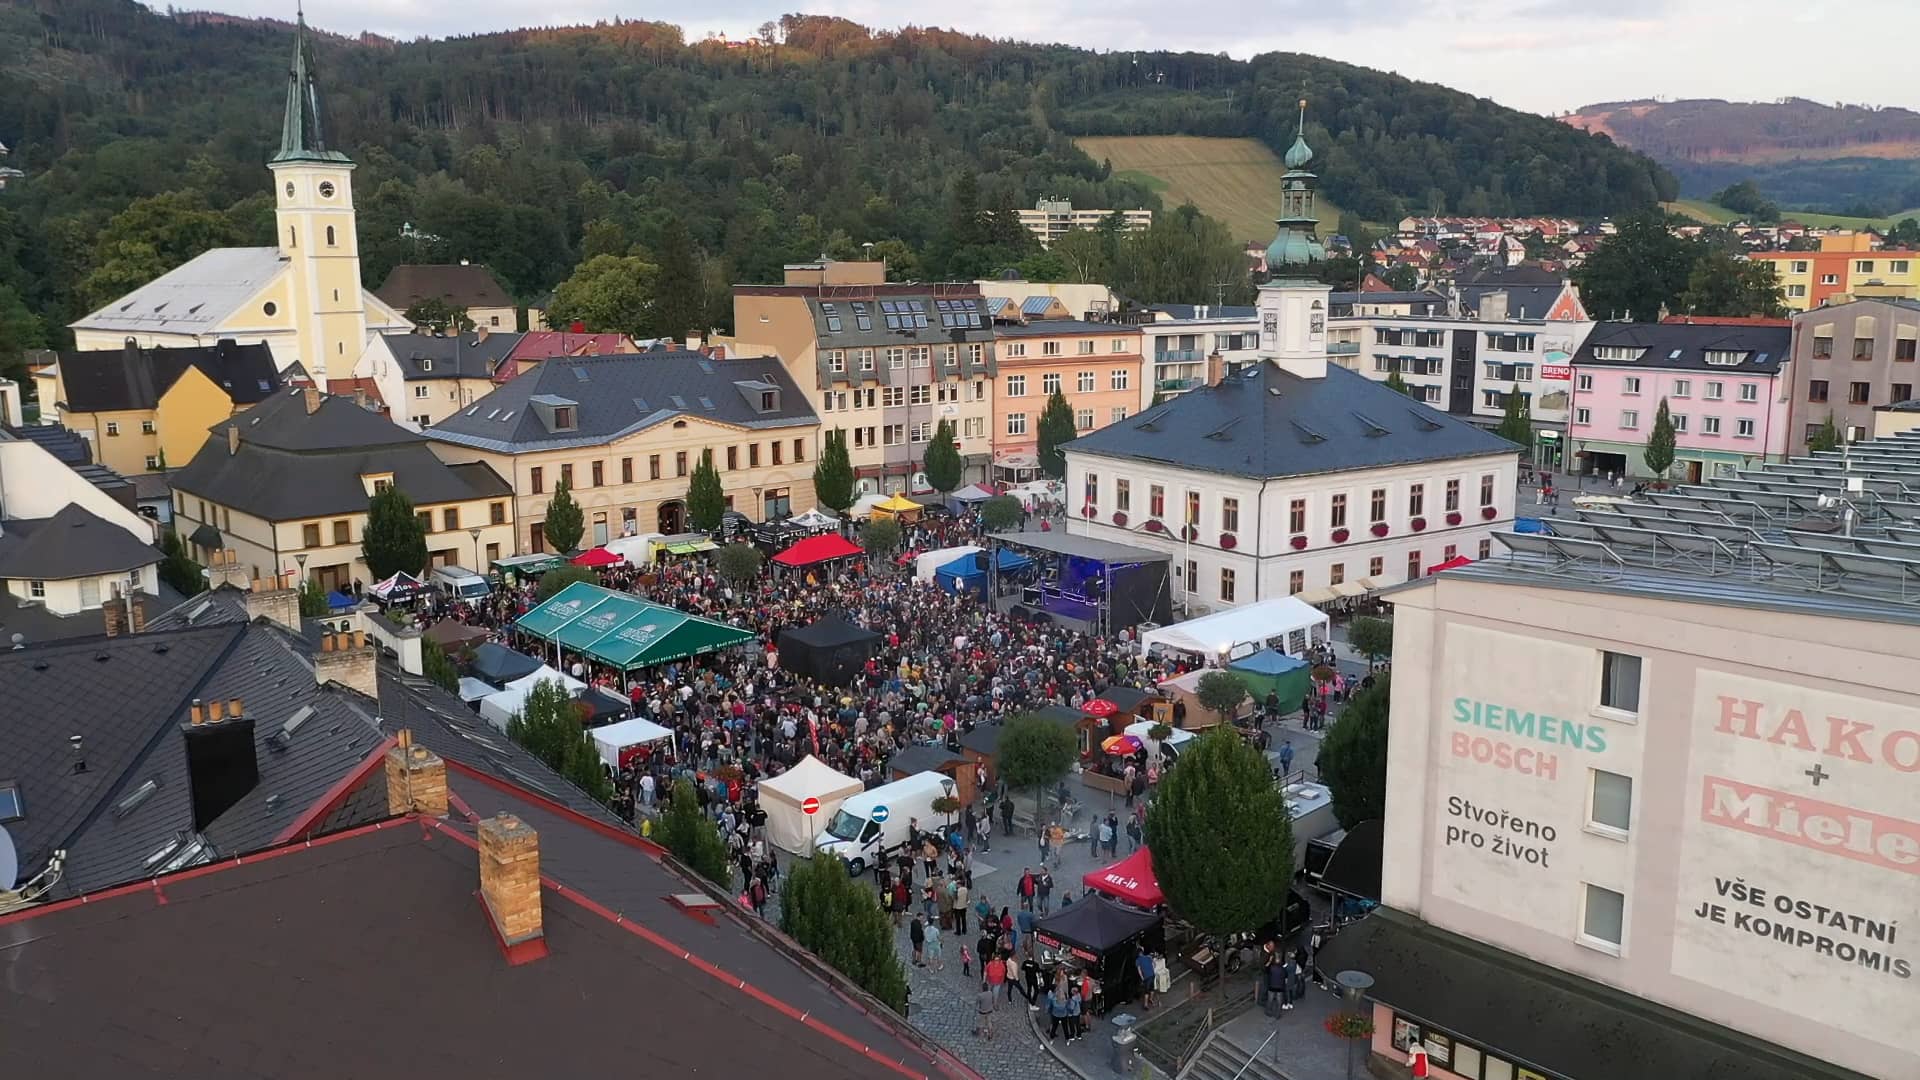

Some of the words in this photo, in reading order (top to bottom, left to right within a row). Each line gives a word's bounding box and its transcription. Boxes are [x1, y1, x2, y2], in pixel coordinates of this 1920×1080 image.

[1542, 366, 1570, 375] BRENO
[1453, 697, 1607, 753] SIEMENS
[1714, 695, 1920, 773] HAKO
[1451, 731, 1558, 781] BOSCH
[1446, 825, 1485, 848] pro
[1491, 834, 1549, 869] život
[1447, 796, 1556, 842] Stvořeno
[1709, 783, 1920, 865] Miele
[1714, 876, 1766, 908] VŠE
[1773, 894, 1898, 944] OSTATNÍ
[1694, 902, 1726, 924] JE
[1733, 911, 1912, 979] KOMPROMIS
